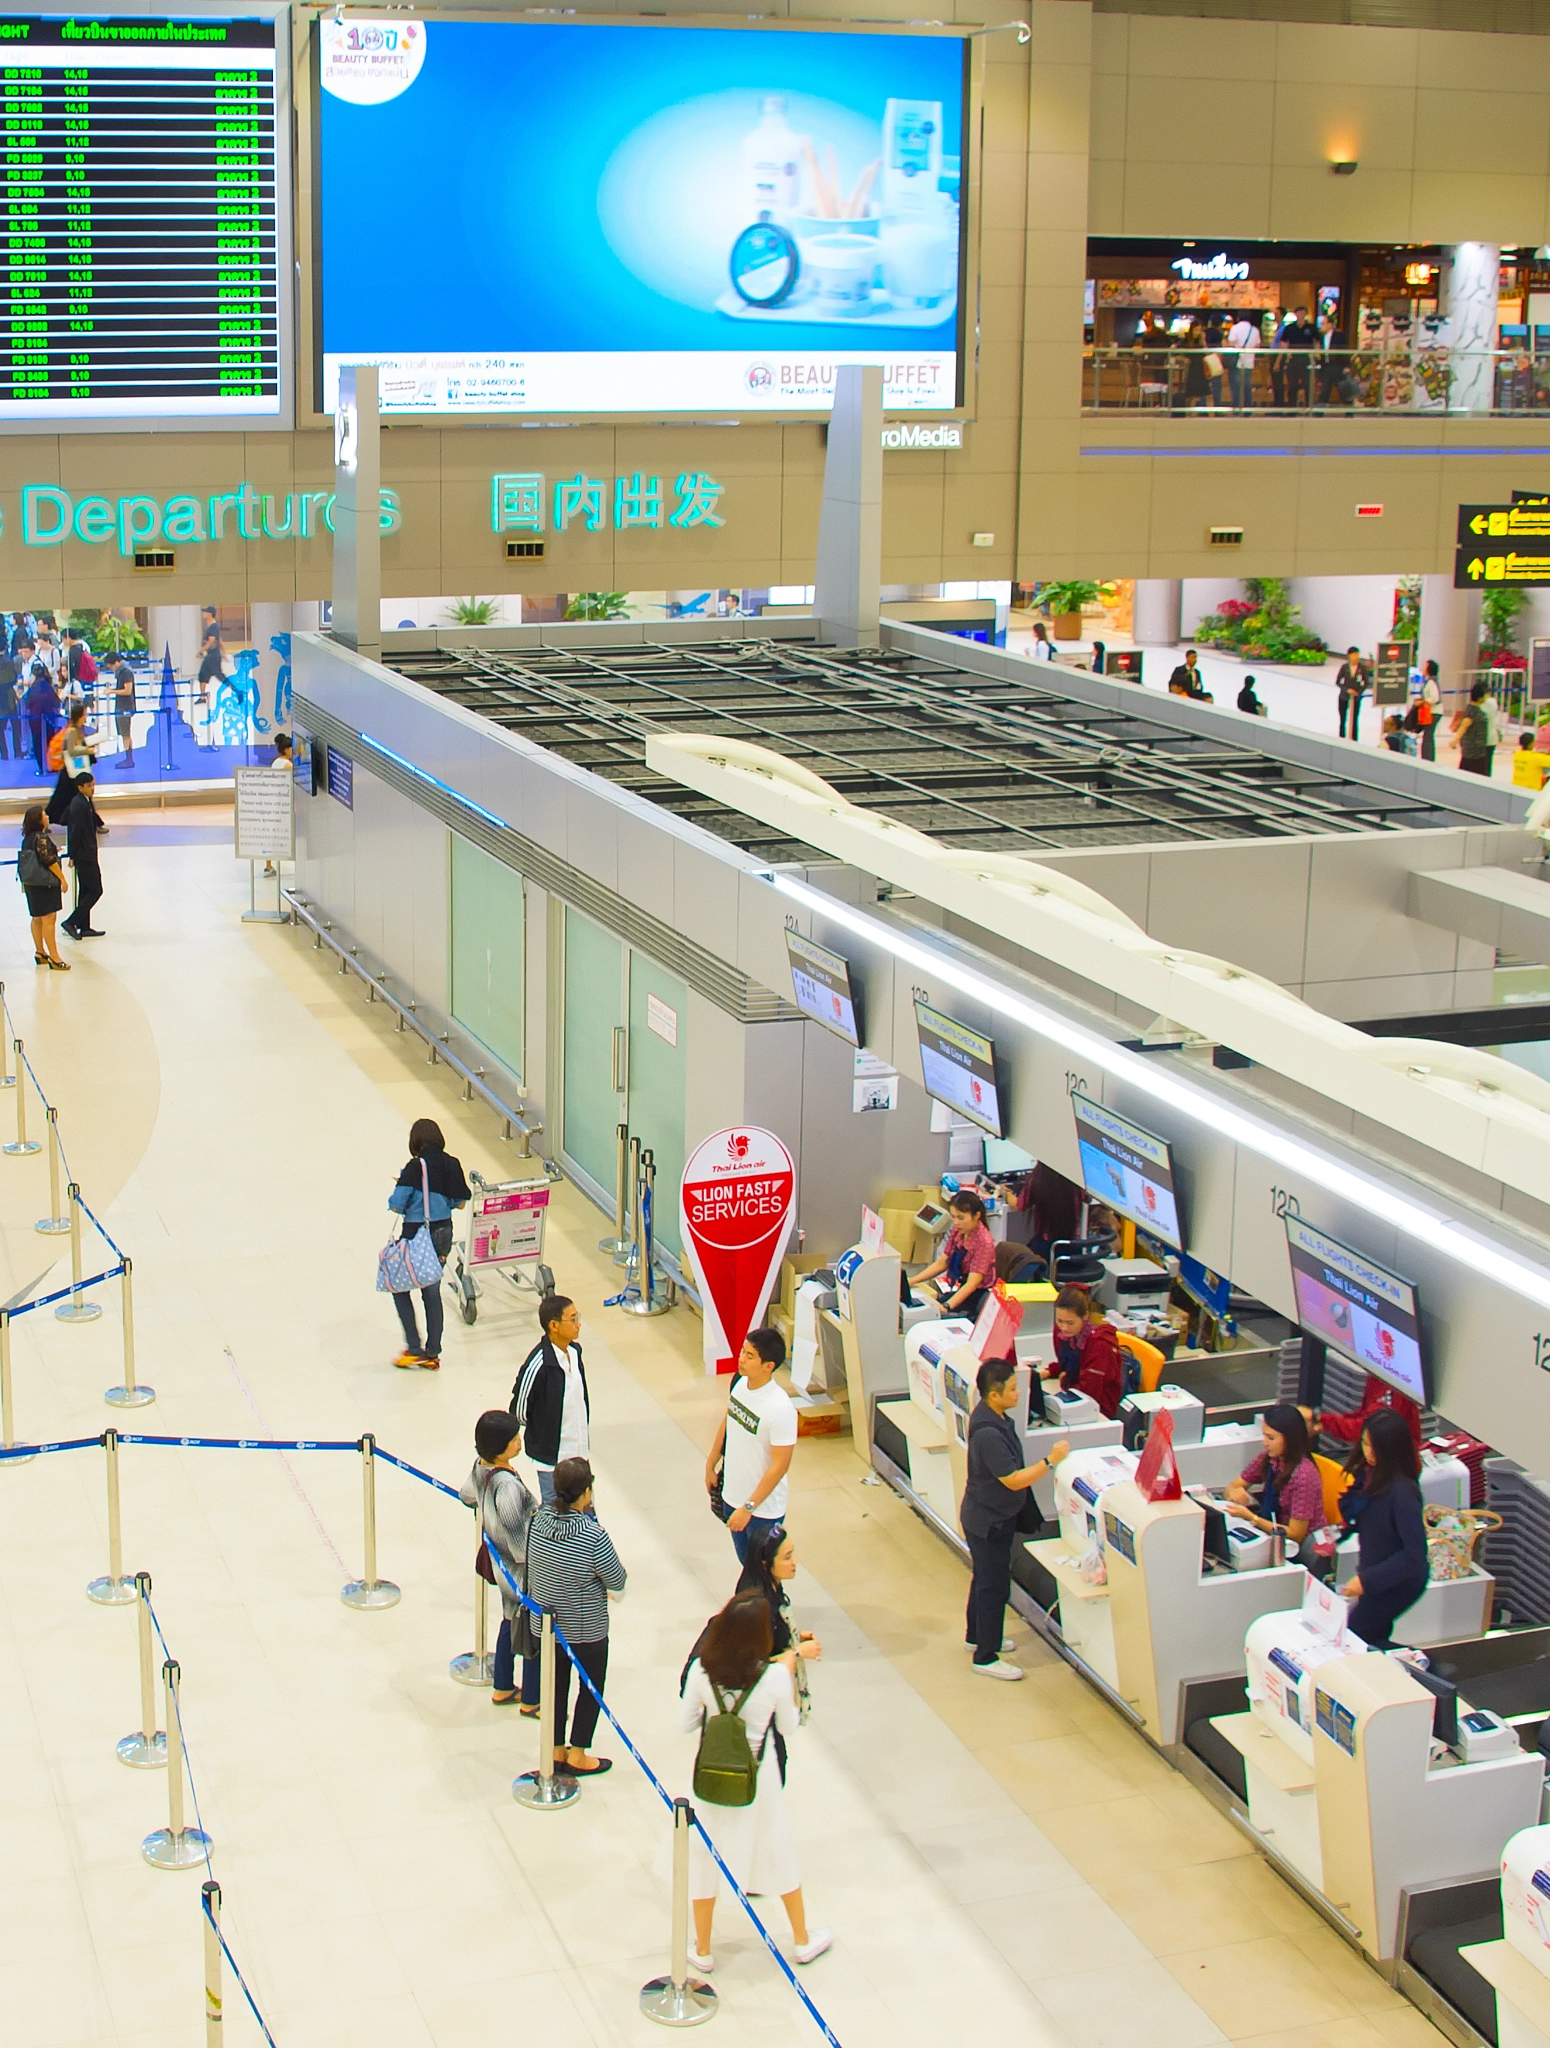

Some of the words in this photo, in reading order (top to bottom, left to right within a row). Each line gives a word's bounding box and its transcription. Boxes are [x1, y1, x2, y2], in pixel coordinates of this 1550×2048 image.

[332, 55, 368, 64] BEAUTY
[371, 55, 404, 65] BUFFET
[250, 71, 258, 81] 2
[250, 88, 258, 98] 2
[250, 104, 258, 114] 2
[250, 121, 258, 131] 2
[251, 138, 258, 148] 2
[251, 154, 258, 164] 2
[251, 171, 260, 181] 2
[252, 187, 260, 198] 2
[252, 204, 260, 214] 2
[252, 221, 260, 230] 2
[252, 237, 260, 247] 2
[252, 254, 260, 264] 2
[253, 270, 260, 280] 2
[253, 286, 260, 296] 2
[253, 303, 262, 313] 2
[253, 320, 262, 330] 2
[254, 336, 262, 346] 2
[254, 352, 262, 362] 2
[485, 359, 505, 369] 240
[254, 369, 262, 378] 2
[254, 385, 262, 394] 2
[492, 472, 727, 533] 国内出发
[1082, 1107, 1094, 1120] ALL
[1101, 1137, 1117, 1154] Thai
[1117, 1146, 1133, 1162] Lion
[1132, 1155, 1144, 1170] Air
[712, 1163, 732, 1173] Thai
[732, 1162, 753, 1172] Lion
[753, 1160, 766, 1168] air
[702, 1185, 733, 1202] LION
[736, 1180, 772, 1198] FAST
[1270, 1185, 1301, 1219] 12D
[691, 1196, 782, 1224] SERVICES
[1299, 1231, 1316, 1250] ALL
[1316, 1240, 1354, 1273] FLIGHTS
[1354, 1262, 1401, 1300] CHECK-IN
[1323, 1268, 1344, 1289] Thai
[1344, 1280, 1365, 1301] Lion
[1364, 1293, 1380, 1311] Air
[1533, 1333, 1550, 1372] 12
[1364, 1349, 1383, 1366] Thai
[1382, 1360, 1401, 1378] Lion
